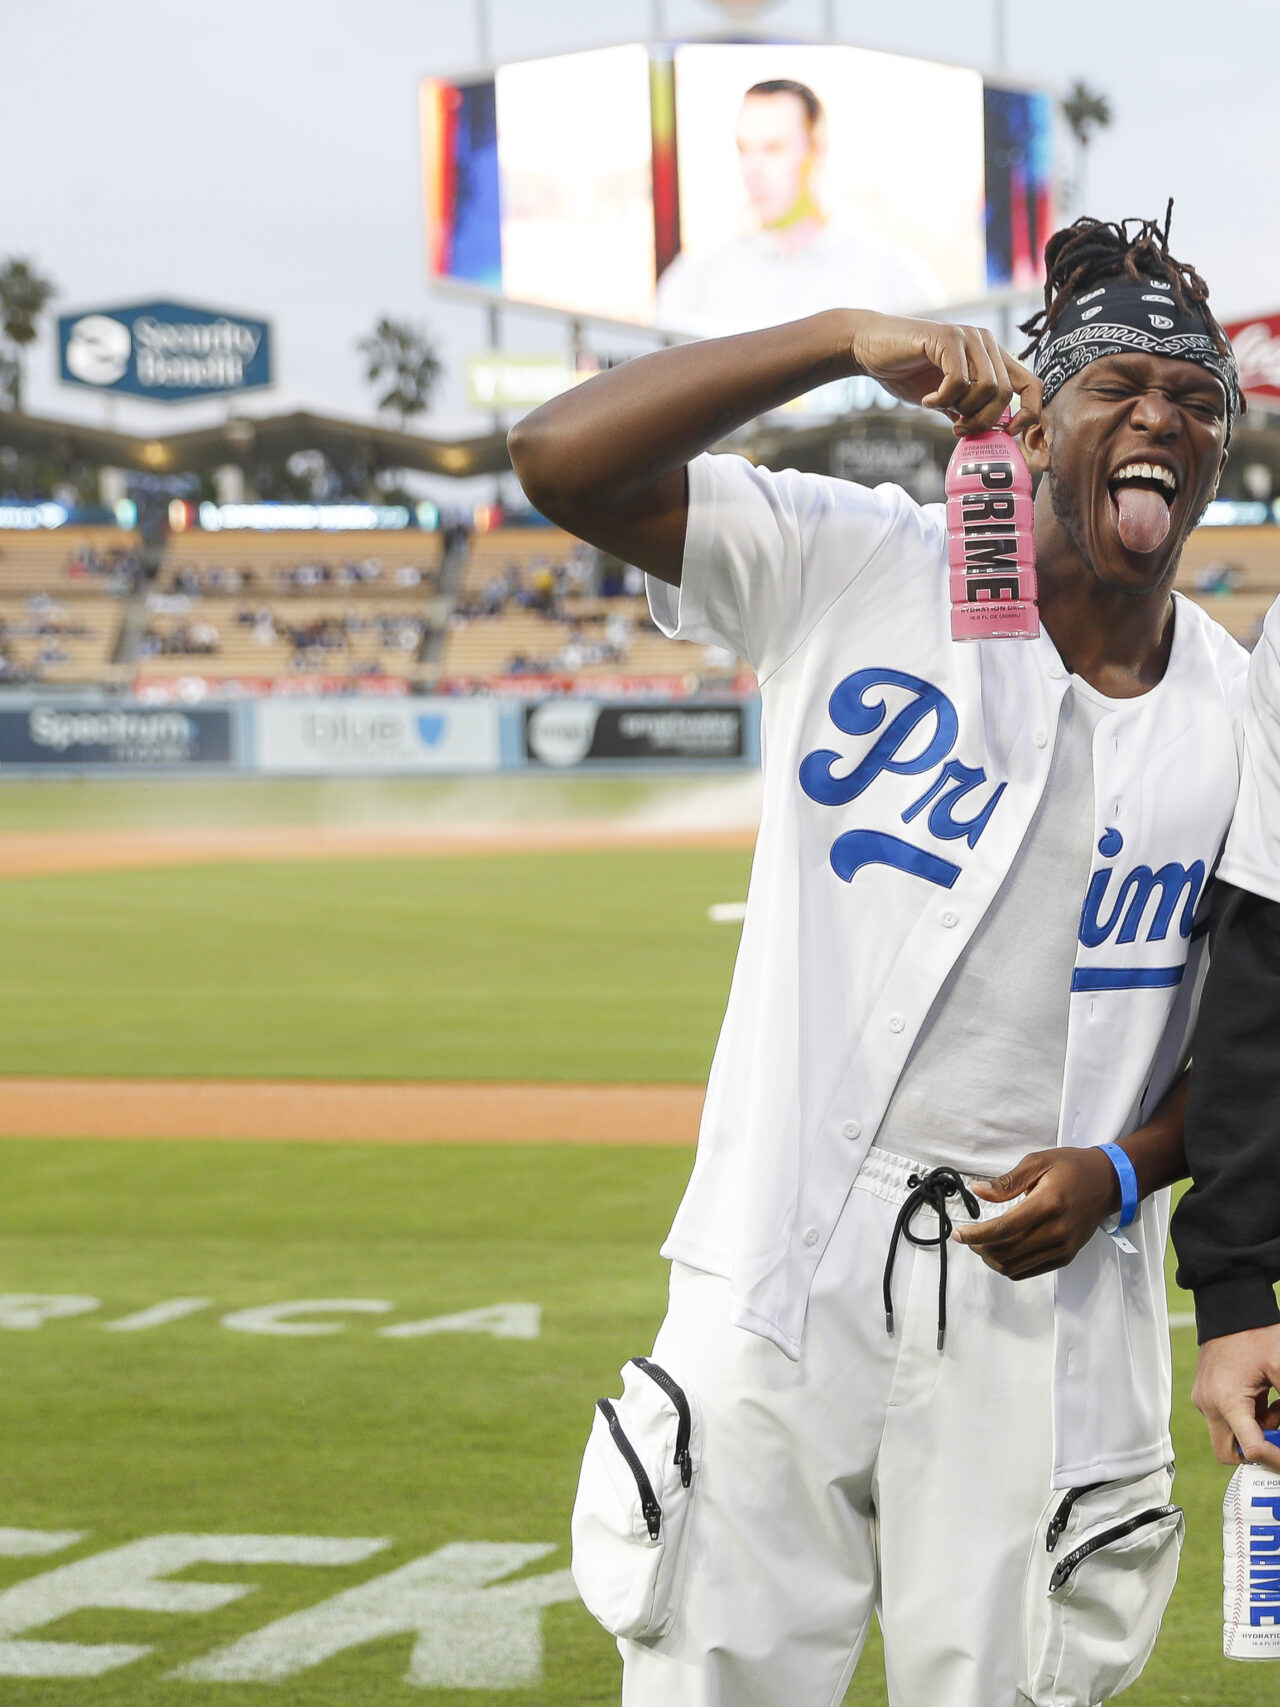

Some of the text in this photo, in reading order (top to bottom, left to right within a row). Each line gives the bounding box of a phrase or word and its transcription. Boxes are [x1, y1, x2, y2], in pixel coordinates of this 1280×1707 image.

[132, 316, 262, 364] Security
[136, 349, 244, 388] Benefit
[960, 461, 1021, 604] PRIME
